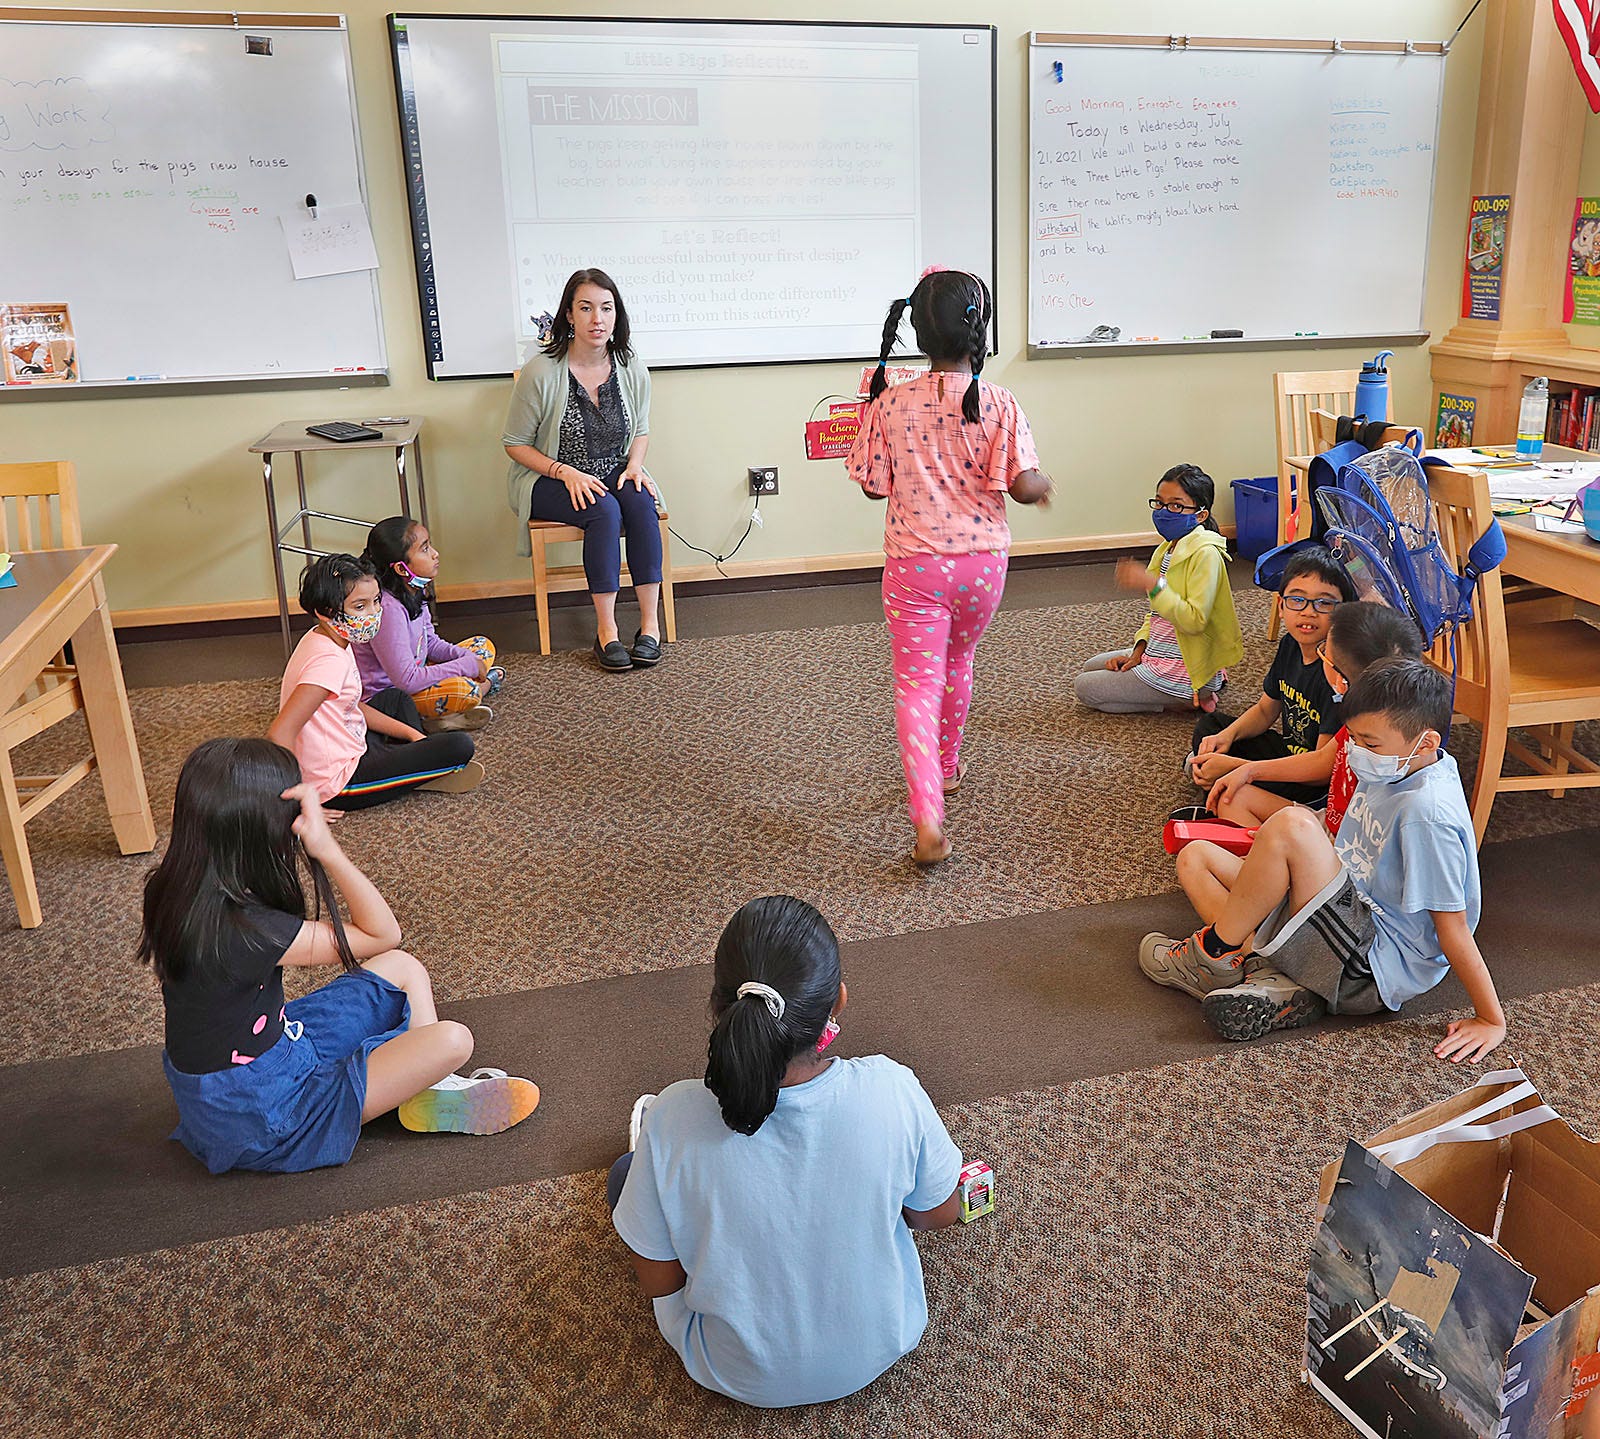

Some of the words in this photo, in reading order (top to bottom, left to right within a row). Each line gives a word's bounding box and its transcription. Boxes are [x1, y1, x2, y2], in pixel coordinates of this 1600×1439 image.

[623, 51, 673, 67] Little
[679, 53, 717, 72] Pigs
[25, 102, 88, 128] Work
[534, 94, 581, 121] THE
[589, 94, 695, 121] MISSION:
[1045, 99, 1072, 114] Good
[1066, 121, 1108, 147] Today
[1119, 122, 1129, 135] is
[1206, 113, 1232, 139] July
[556, 137, 583, 151] The
[587, 138, 613, 154] pigs
[655, 138, 697, 154] getting
[1091, 147, 1109, 160] We
[1116, 141, 1135, 157] will
[1143, 140, 1168, 153] build
[1175, 141, 1182, 149] a
[1187, 140, 1208, 149] new
[1214, 136, 1243, 148] home
[18, 168, 44, 188] your
[57, 160, 103, 180] design
[111, 157, 130, 174] for
[138, 158, 160, 172] the
[209, 161, 239, 172] new
[249, 155, 289, 168] house
[1038, 175, 1054, 190] for
[1060, 175, 1078, 187] the
[1085, 170, 1111, 182] Three
[1174, 156, 1204, 169] Please
[1213, 155, 1241, 165] make
[168, 190, 176, 198] a
[1094, 198, 1112, 207] new
[1115, 189, 1142, 201] home
[1147, 188, 1156, 200] is
[1162, 180, 1192, 194] stable
[1230, 176, 1240, 186] to
[241, 205, 261, 215] are
[1473, 198, 1510, 213] 000-099
[208, 218, 237, 234] they?
[1038, 222, 1080, 236] withstand
[1087, 217, 1101, 230] the
[1136, 209, 1163, 226] mighty
[1219, 201, 1240, 212] hard
[660, 229, 706, 244] Let's
[542, 252, 583, 266] What
[586, 254, 617, 265] was
[619, 249, 692, 266] successful
[696, 248, 737, 263] about
[740, 251, 774, 267] your
[776, 248, 805, 262] first
[808, 247, 861, 264] design?
[1039, 244, 1057, 258] and
[1064, 241, 1077, 255] be
[652, 270, 675, 286] did
[680, 272, 706, 288] you
[710, 268, 755, 284] make?
[1041, 268, 1070, 287] Love,
[643, 290, 677, 306] wish
[681, 292, 706, 307] you
[711, 287, 737, 303] had
[741, 286, 776, 301] done
[779, 284, 857, 304] differently?
[644, 310, 682, 325] learn
[685, 308, 722, 323] from
[724, 306, 750, 321] this
[753, 304, 810, 323] activity?
[1440, 396, 1475, 413] 200-299
[819, 431, 858, 444] Pomegran
[829, 422, 858, 435] Cherry
